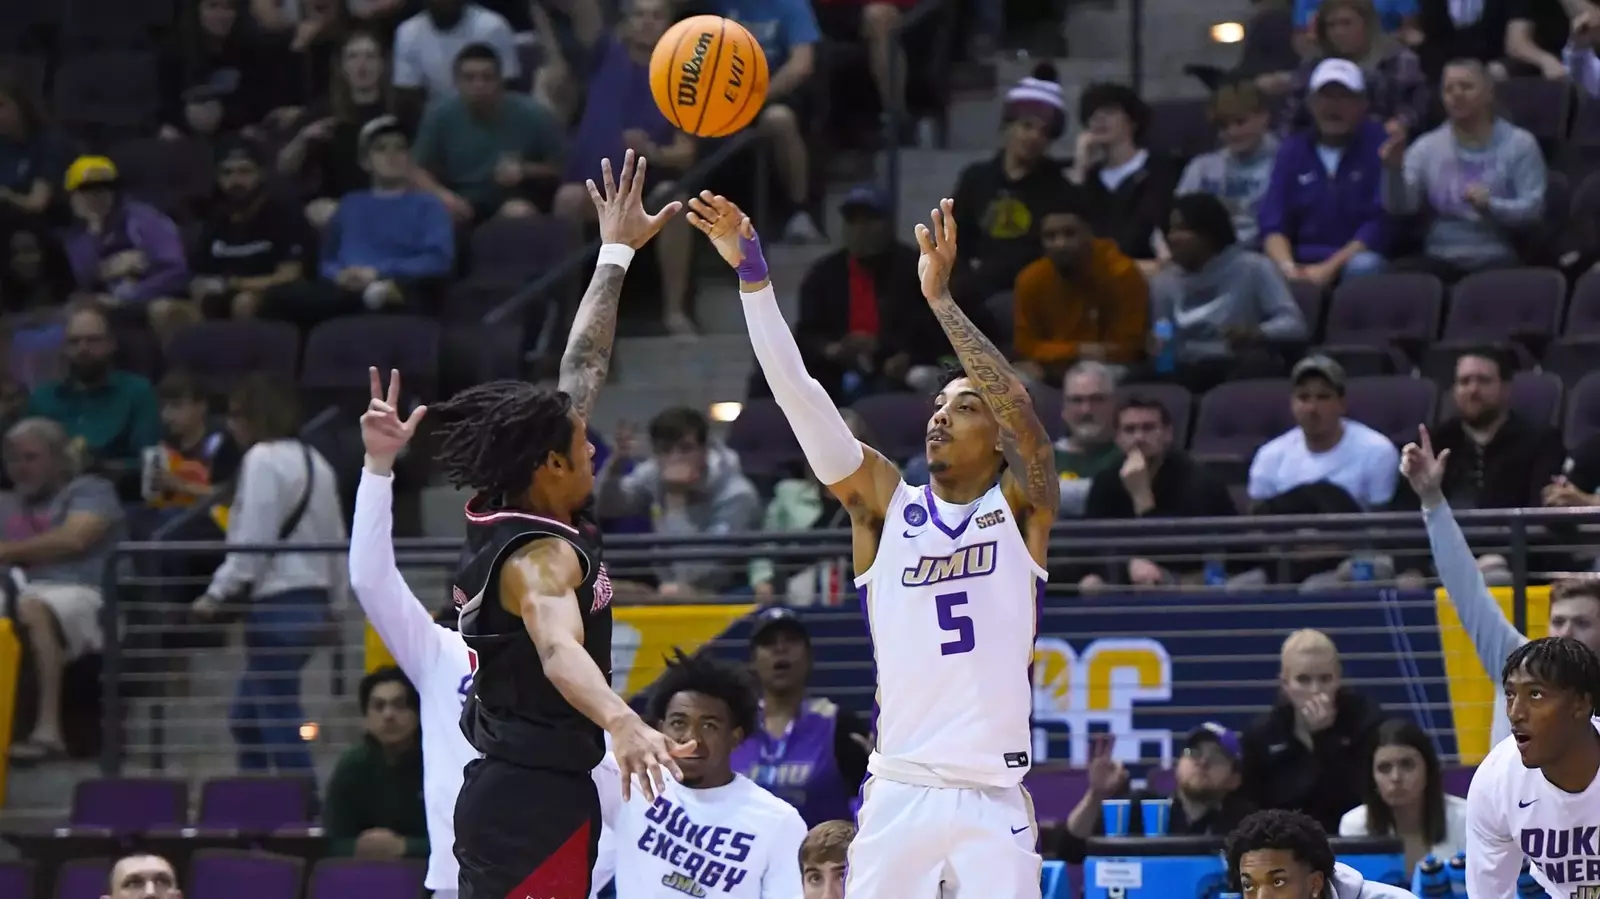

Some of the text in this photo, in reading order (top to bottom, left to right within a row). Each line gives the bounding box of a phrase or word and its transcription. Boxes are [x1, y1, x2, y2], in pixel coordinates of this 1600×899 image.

[679, 32, 714, 106] Wilson
[975, 508, 1006, 529] SBC
[902, 541, 998, 588] JMU
[935, 591, 976, 656] 5
[637, 824, 748, 893] ENERGY
[645, 795, 756, 863] DUKES
[1520, 826, 1600, 858] DUK
